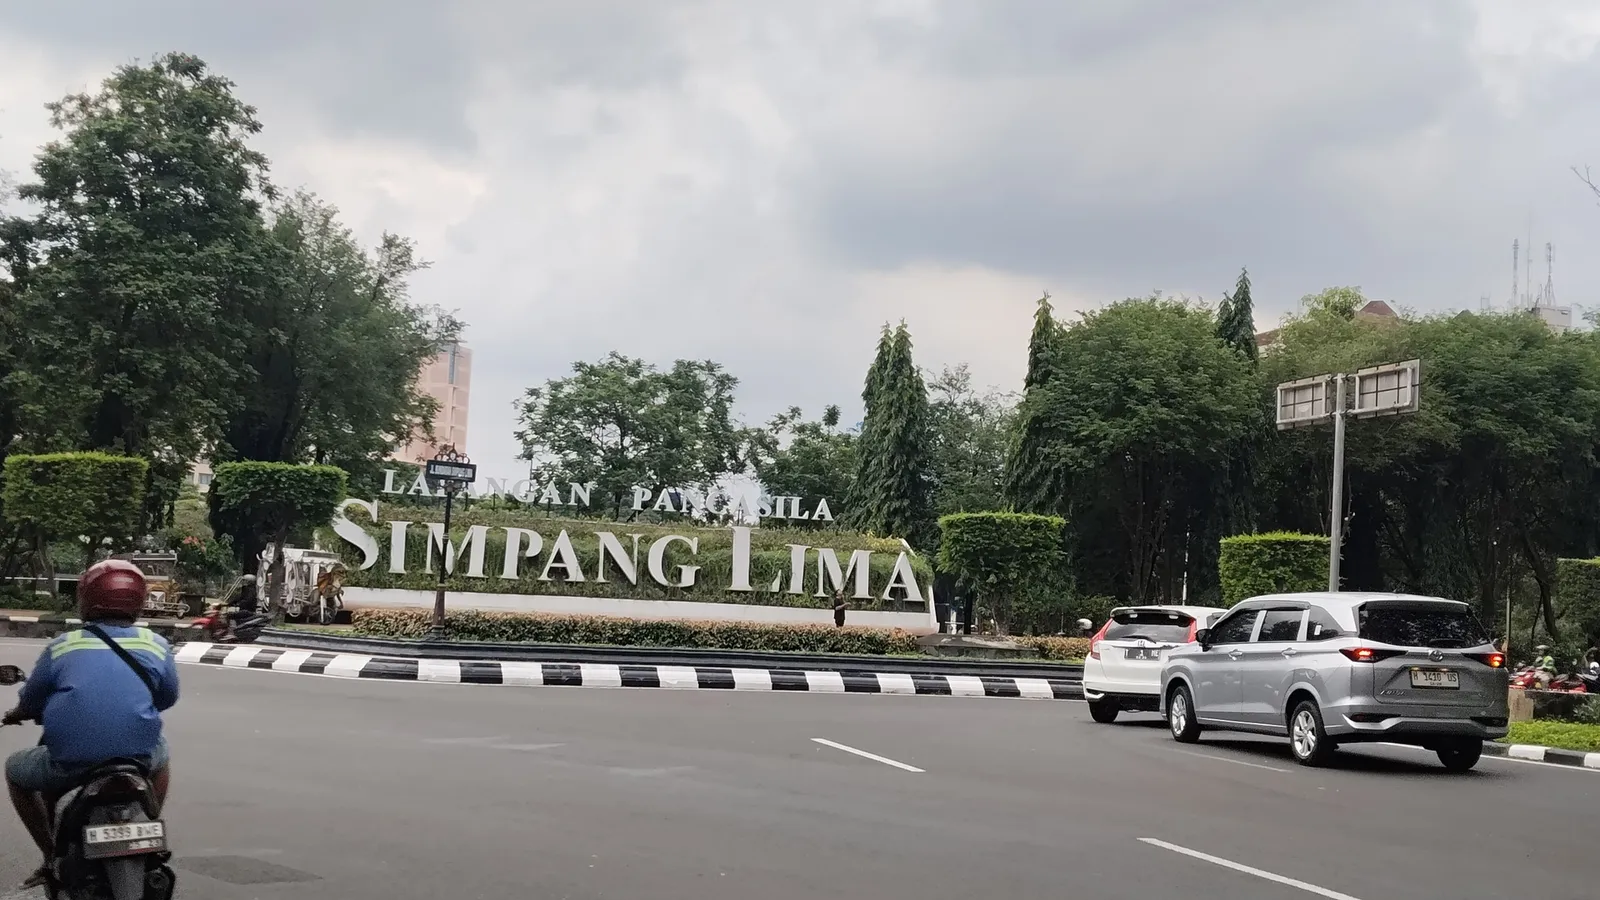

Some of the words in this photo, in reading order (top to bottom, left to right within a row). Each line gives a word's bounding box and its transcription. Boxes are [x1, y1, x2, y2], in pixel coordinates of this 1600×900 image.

[381, 468, 596, 507] LAANGAN
[631, 485, 834, 522] PANCASILA
[332, 498, 701, 589] SIMPANG
[726, 526, 926, 601] LIMA
[1446, 673, 1458, 683] US
[89, 829, 98, 842] H
